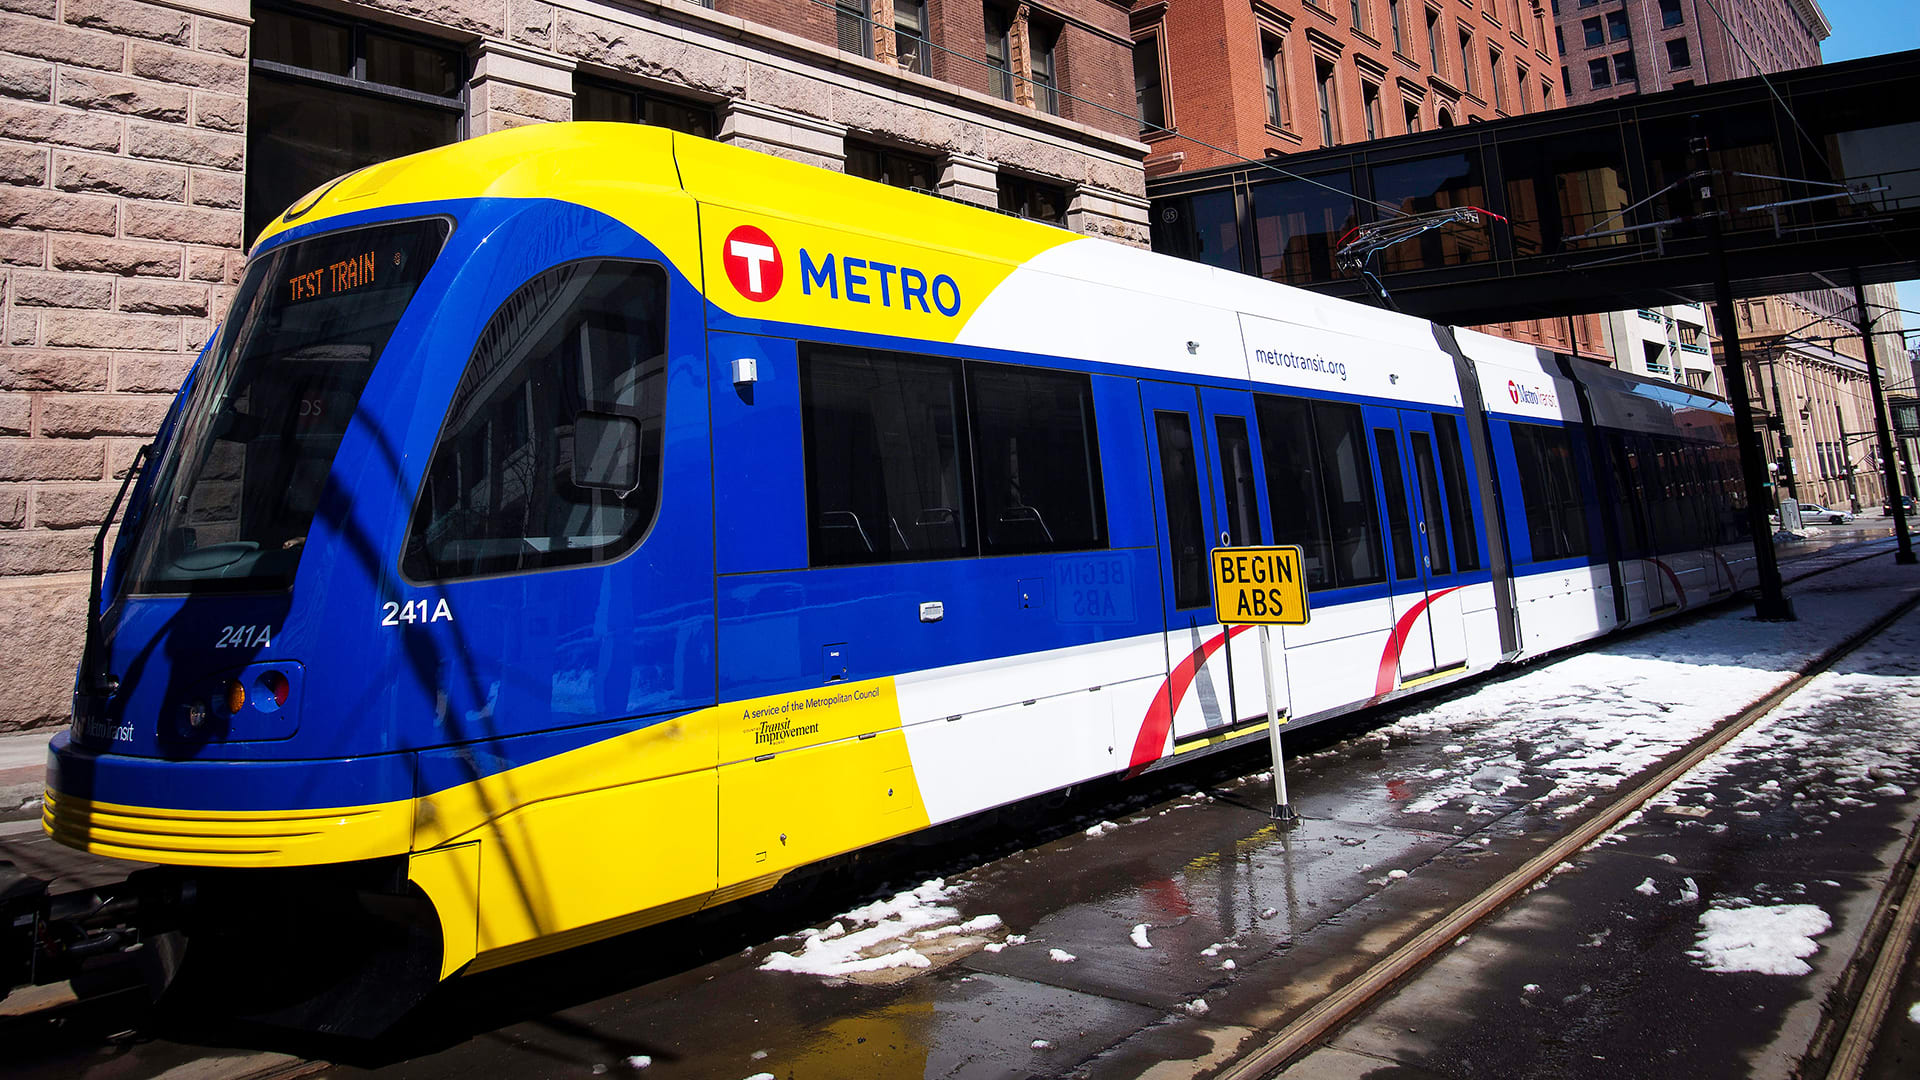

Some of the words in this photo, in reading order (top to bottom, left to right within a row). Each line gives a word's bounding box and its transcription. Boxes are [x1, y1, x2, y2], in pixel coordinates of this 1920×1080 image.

[330, 251, 375, 292] TRAIN
[729, 240, 775, 294] T
[799, 248, 961, 317] METRO
[1255, 348, 1347, 381] metrotransit.org
[1220, 555, 1293, 584] BEGIN
[382, 598, 454, 627] 241A
[1237, 588, 1283, 617] ABS
[215, 624, 271, 648] 241A
[743, 709, 751, 720] A
[751, 704, 780, 719] service
[781, 701, 790, 713] of
[791, 701, 804, 712] the
[805, 693, 853, 709] Metropolitan
[853, 686, 880, 701] Council
[755, 723, 819, 745] Improvement
[760, 717, 791, 734] Transit
